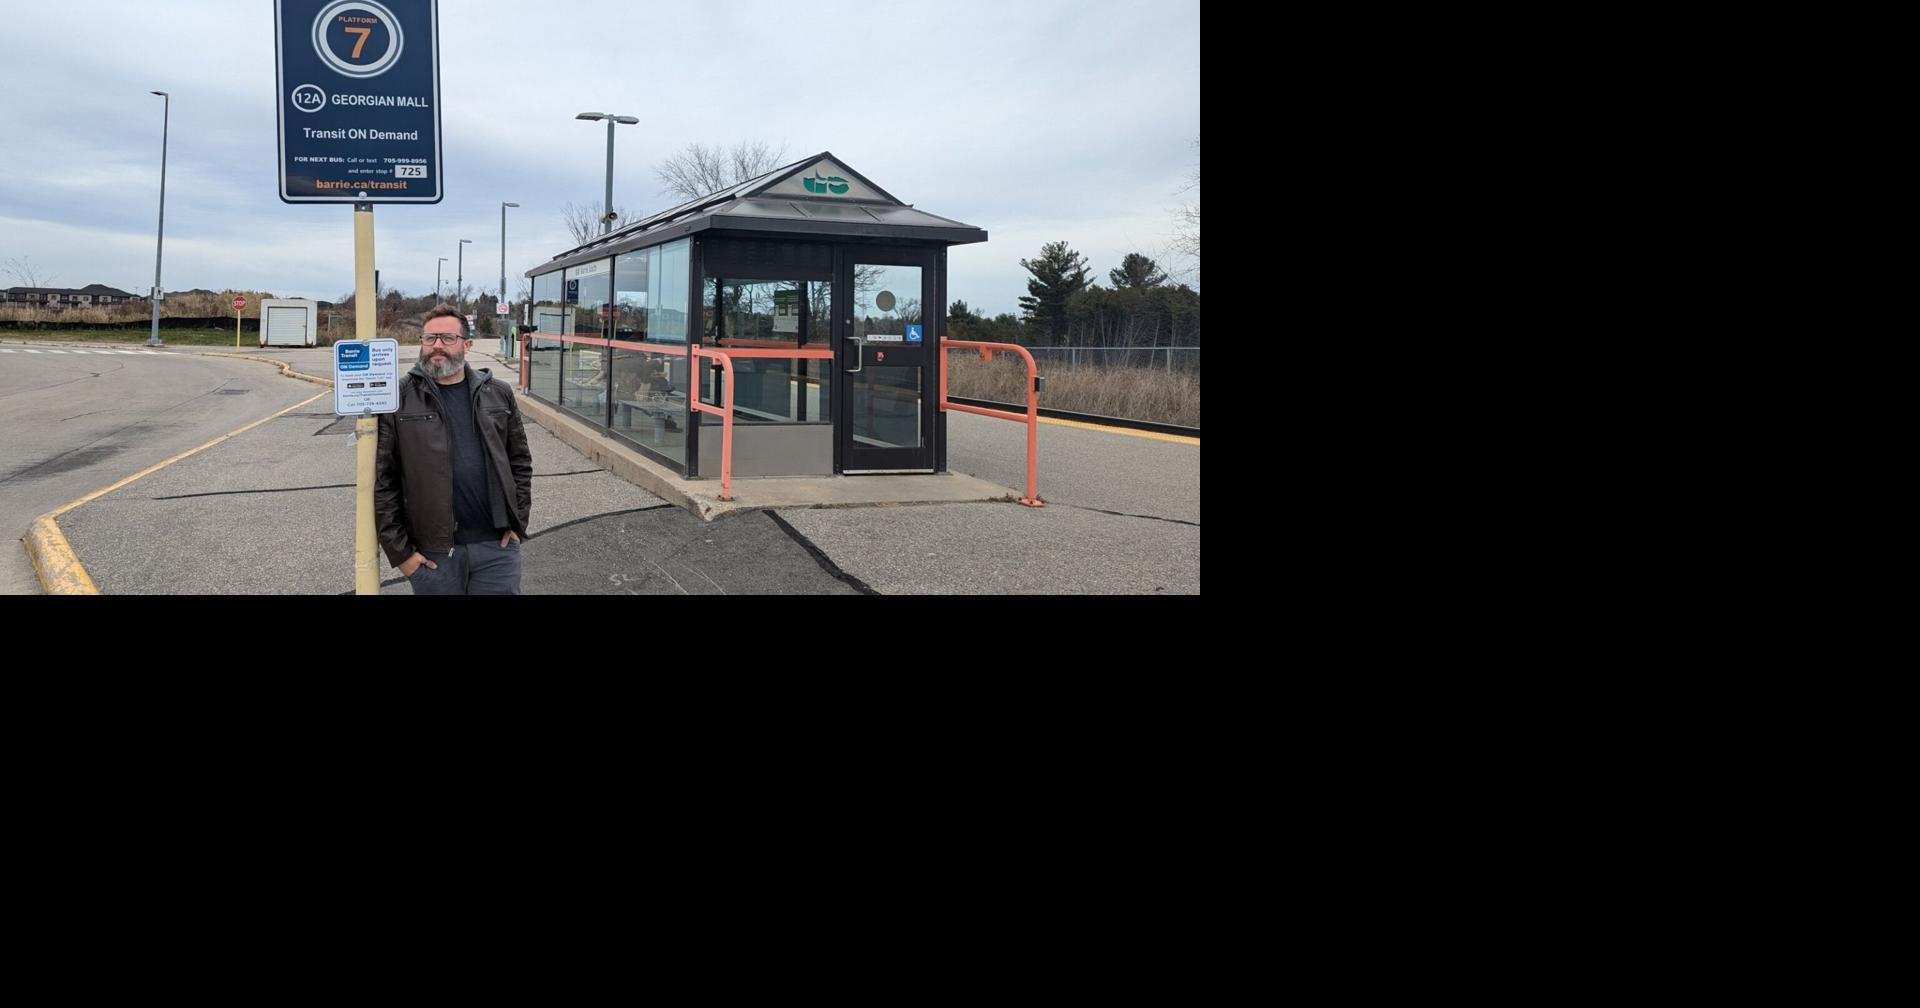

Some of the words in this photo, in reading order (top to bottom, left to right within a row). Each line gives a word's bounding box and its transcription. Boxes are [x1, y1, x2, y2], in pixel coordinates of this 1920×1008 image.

[338, 16, 378, 24] PLATFORM
[345, 27, 371, 59] 7
[296, 93, 321, 104] 12A
[331, 94, 395, 107] GEORGIAN
[397, 96, 429, 107] MALL
[303, 127, 346, 139] Transit
[348, 128, 367, 140] ON
[369, 129, 418, 141] Demand
[401, 167, 421, 176] 725
[316, 179, 407, 189] barrie.ca/transit
